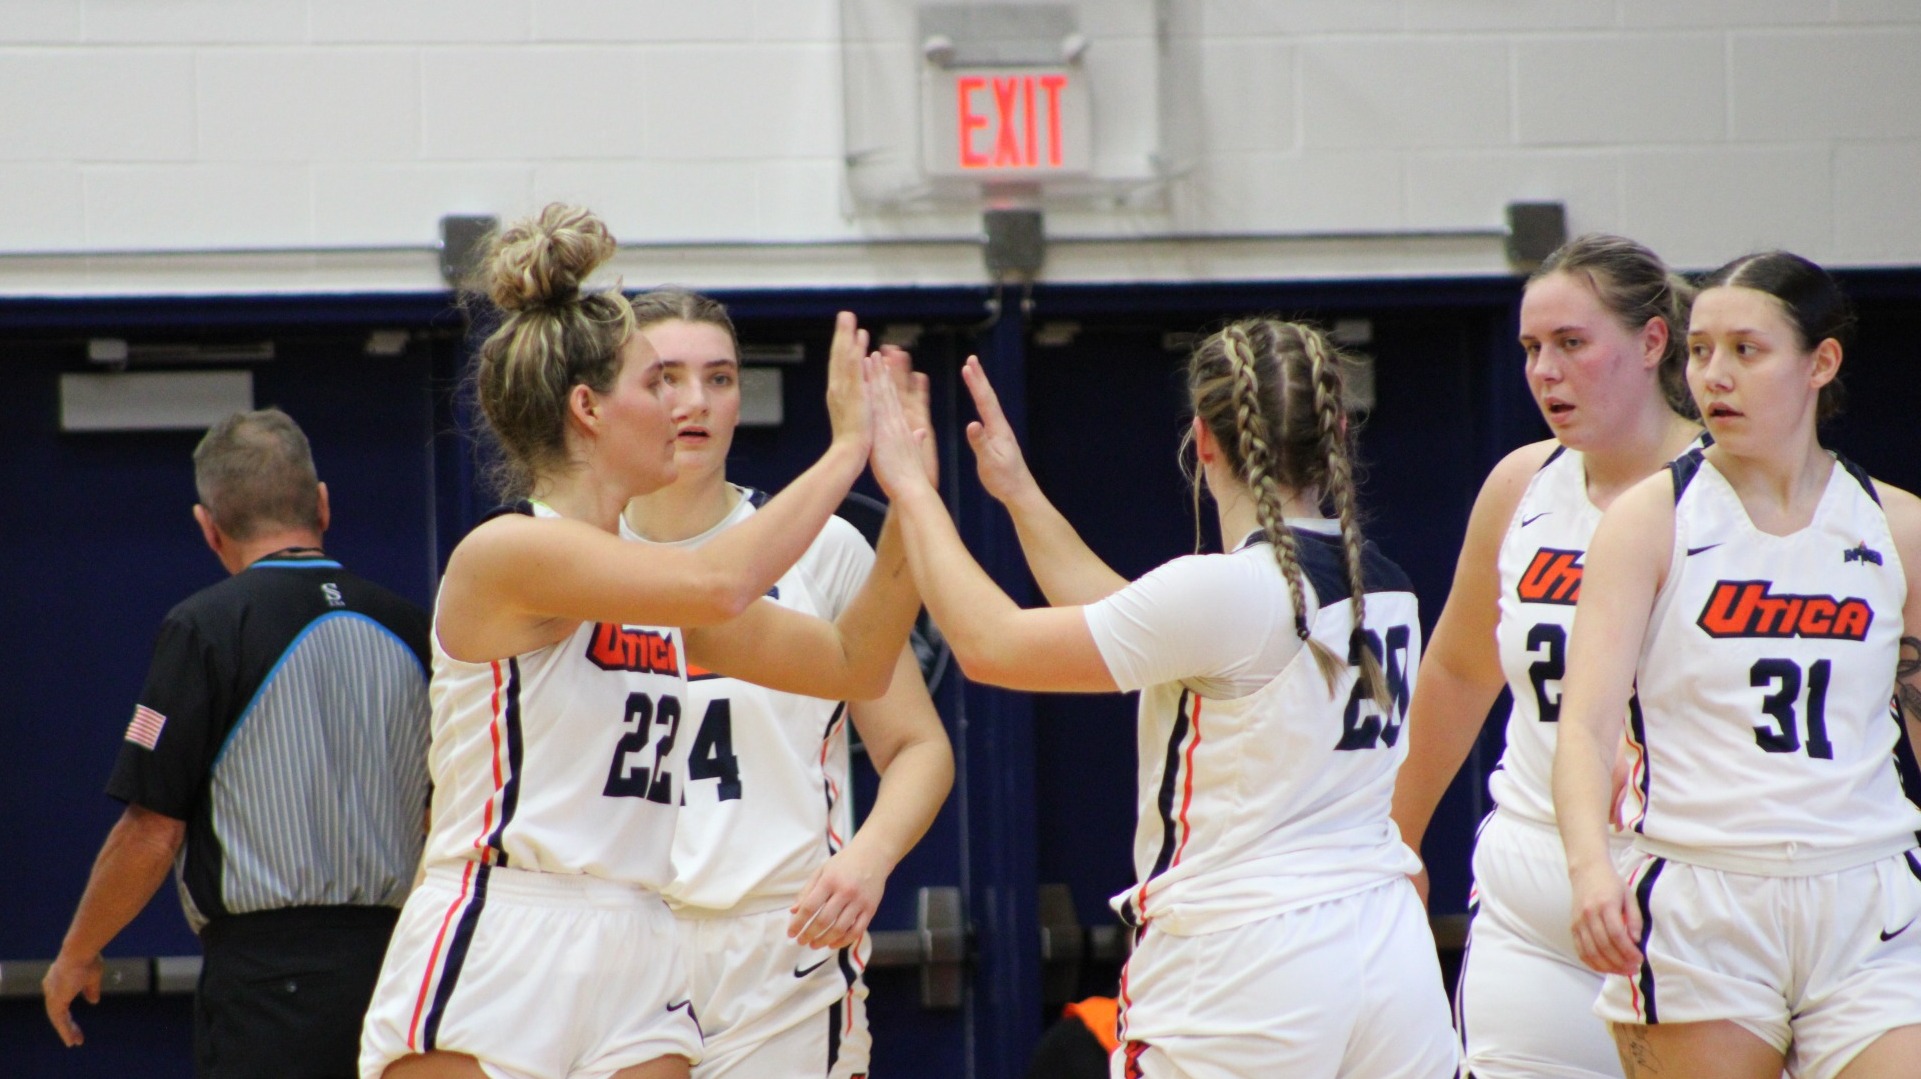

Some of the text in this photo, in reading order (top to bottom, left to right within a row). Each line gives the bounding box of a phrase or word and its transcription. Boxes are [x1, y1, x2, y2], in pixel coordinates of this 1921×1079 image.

[957, 76, 1068, 168] EXIT
[1696, 580, 1874, 641] UTICA
[602, 691, 682, 805] 22
[680, 698, 742, 806] 4
[1750, 658, 1833, 759] 31
